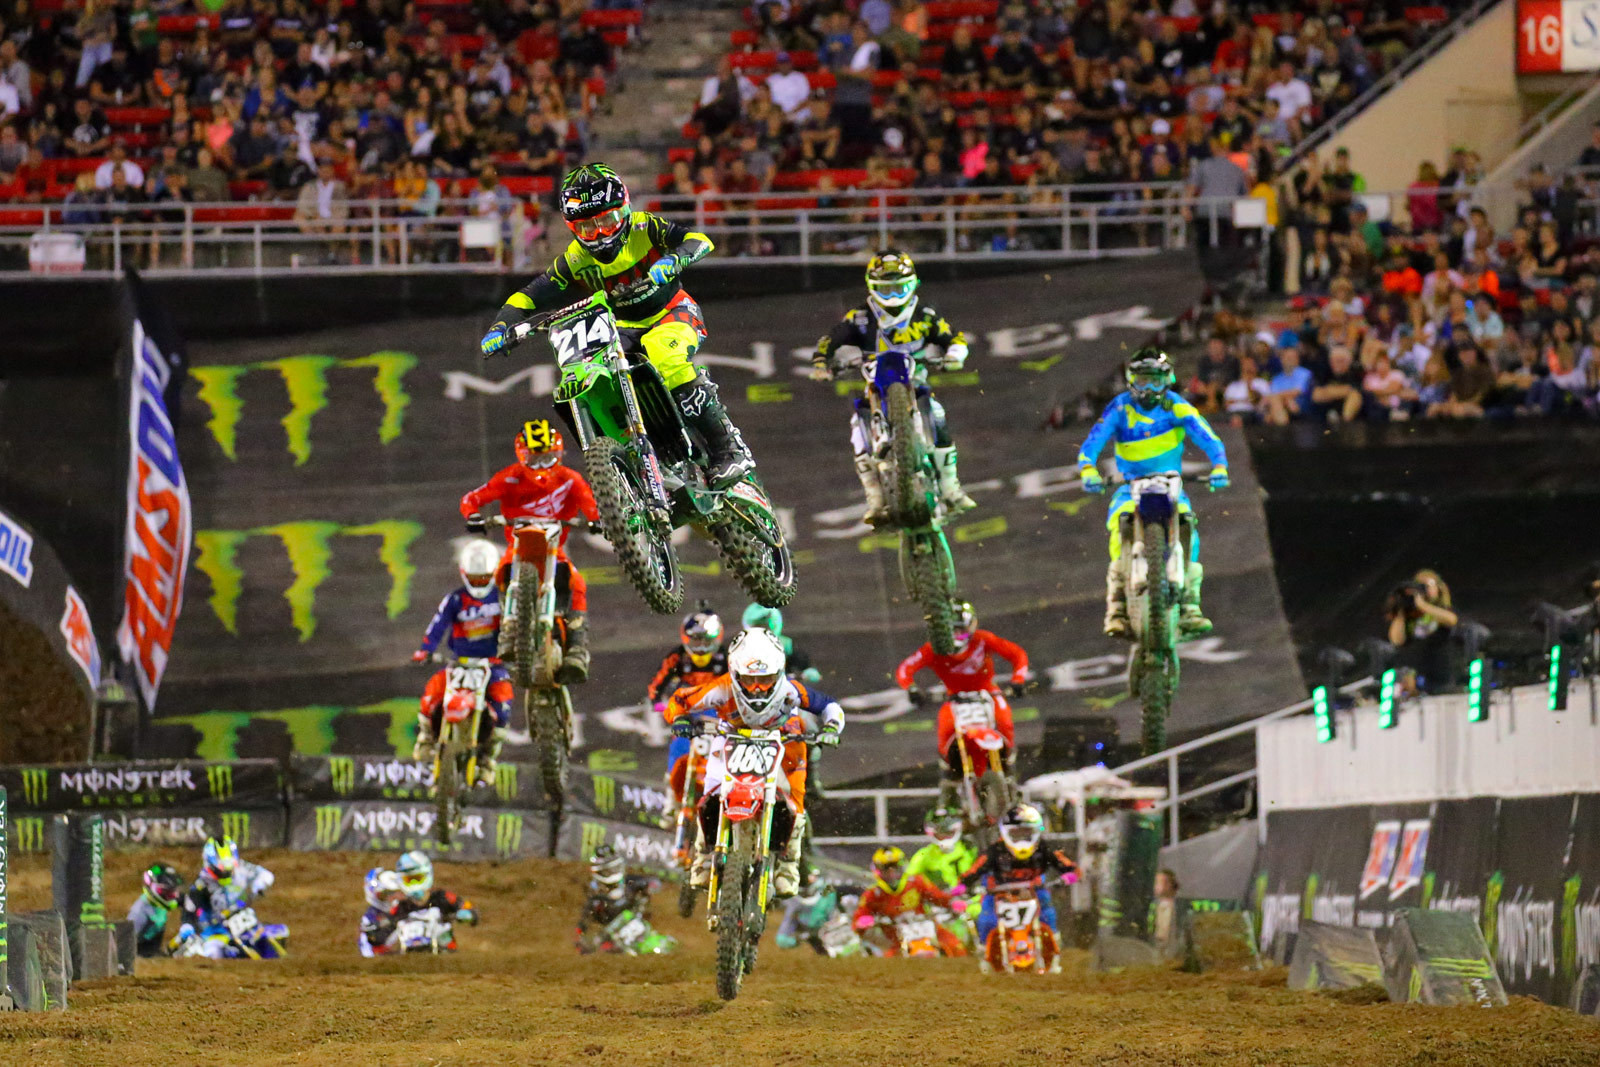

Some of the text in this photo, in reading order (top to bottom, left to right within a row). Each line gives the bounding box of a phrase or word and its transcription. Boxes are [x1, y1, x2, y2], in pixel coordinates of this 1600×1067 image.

[1521, 14, 1560, 55] 16
[551, 312, 611, 366] 214
[642, 453, 661, 501] DUNLOP
[60, 767, 196, 795] MONSTER
[103, 815, 208, 842] NSTER
[999, 901, 1036, 928] 37
